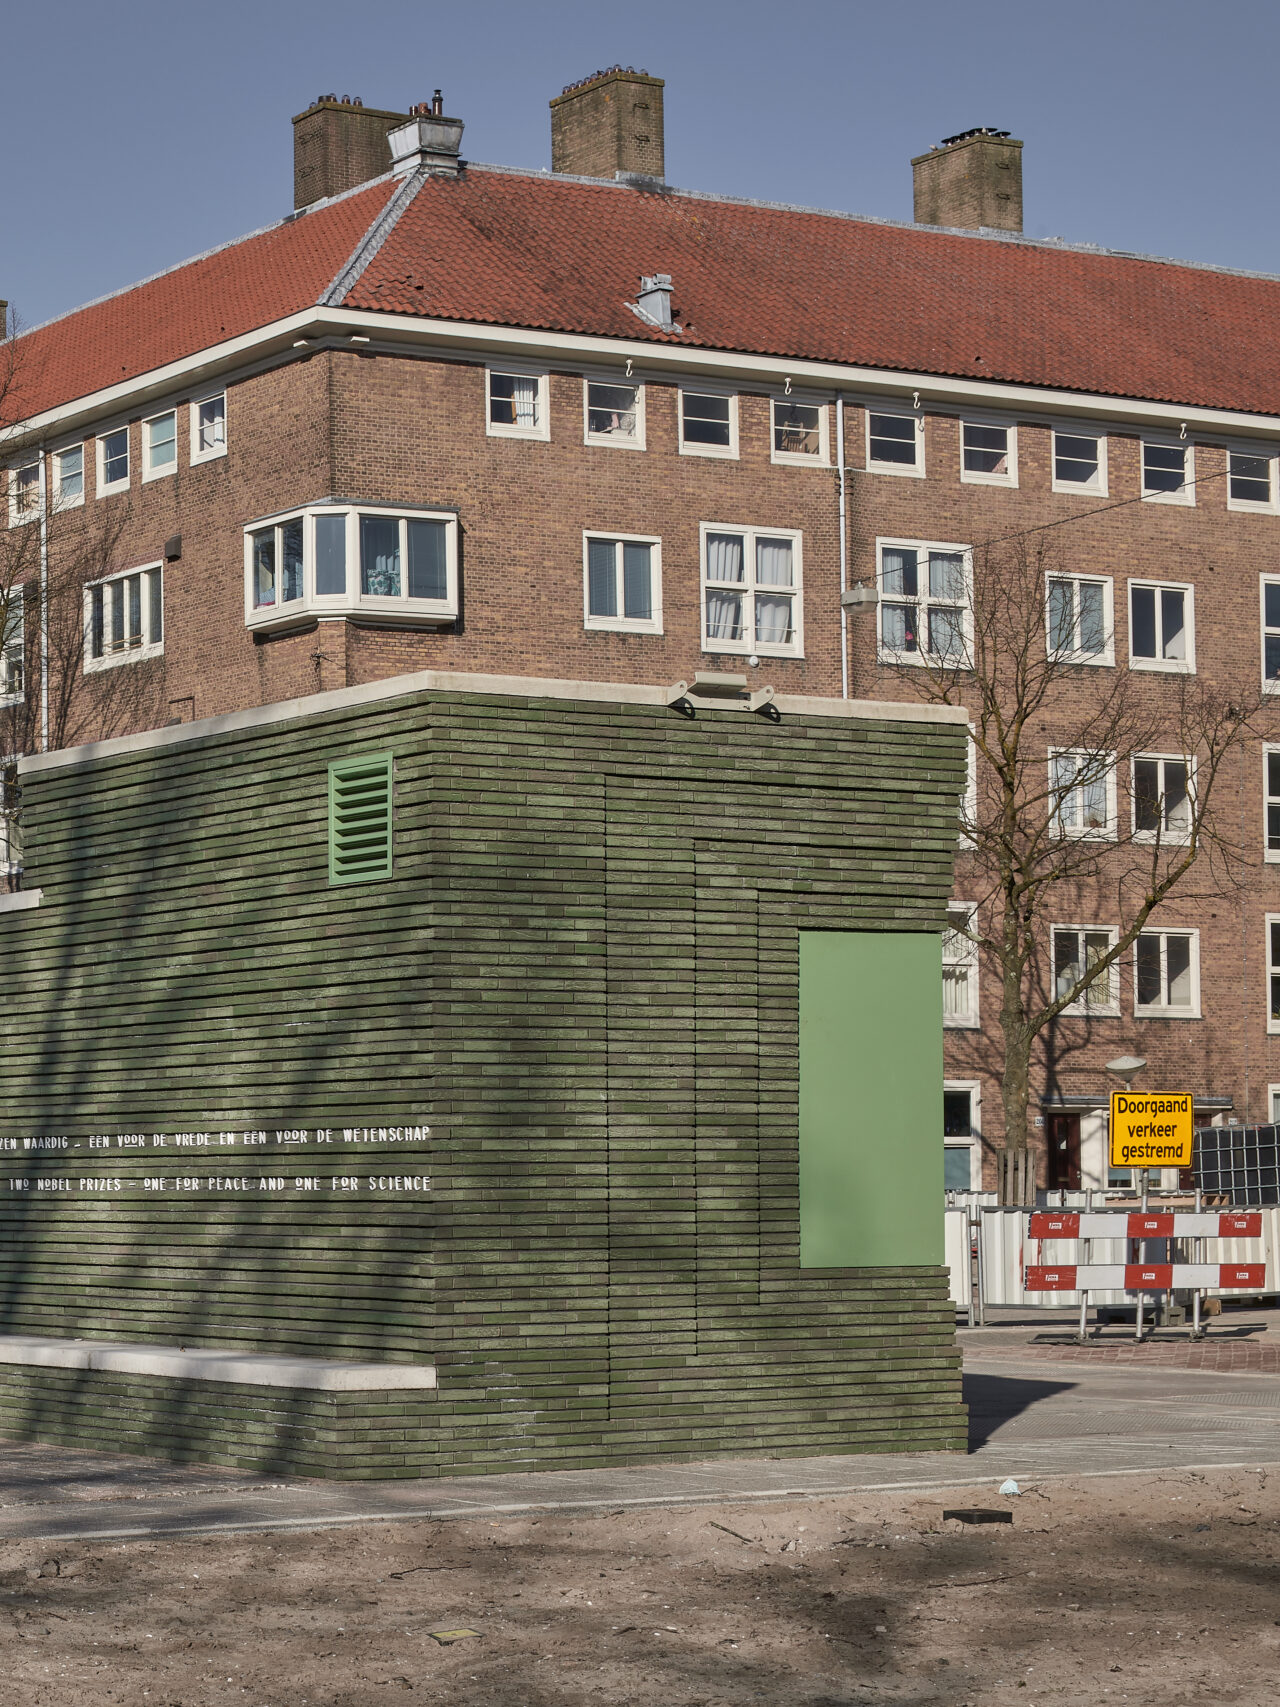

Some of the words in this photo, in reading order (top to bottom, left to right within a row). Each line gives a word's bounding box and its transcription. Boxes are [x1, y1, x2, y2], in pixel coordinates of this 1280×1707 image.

[1118, 1097, 1187, 1118] Doorgaand
[23, 1136, 68, 1150] WAARDIG
[117, 1134, 145, 1148] VOOR
[153, 1133, 167, 1147] DE
[175, 1132, 211, 1146] VREDE
[220, 1132, 234, 1145] EN
[276, 1130, 307, 1144] VOOR
[317, 1129, 333, 1143] DE
[343, 1126, 430, 1143] WETENSCHAP
[1128, 1122, 1177, 1138] verkeer
[1122, 1143, 1183, 1163] gestremd
[9, 1179, 29, 1191] TWO
[37, 1179, 72, 1191] NOBEL
[79, 1178, 121, 1191] PRIZES
[144, 1178, 167, 1191] ONE
[176, 1178, 199, 1191] FOR
[208, 1178, 248, 1191] PEACE
[259, 1177, 285, 1191] AND
[296, 1177, 321, 1191] ONE
[332, 1177, 358, 1191] FOR
[369, 1177, 431, 1191] SCIENCE
